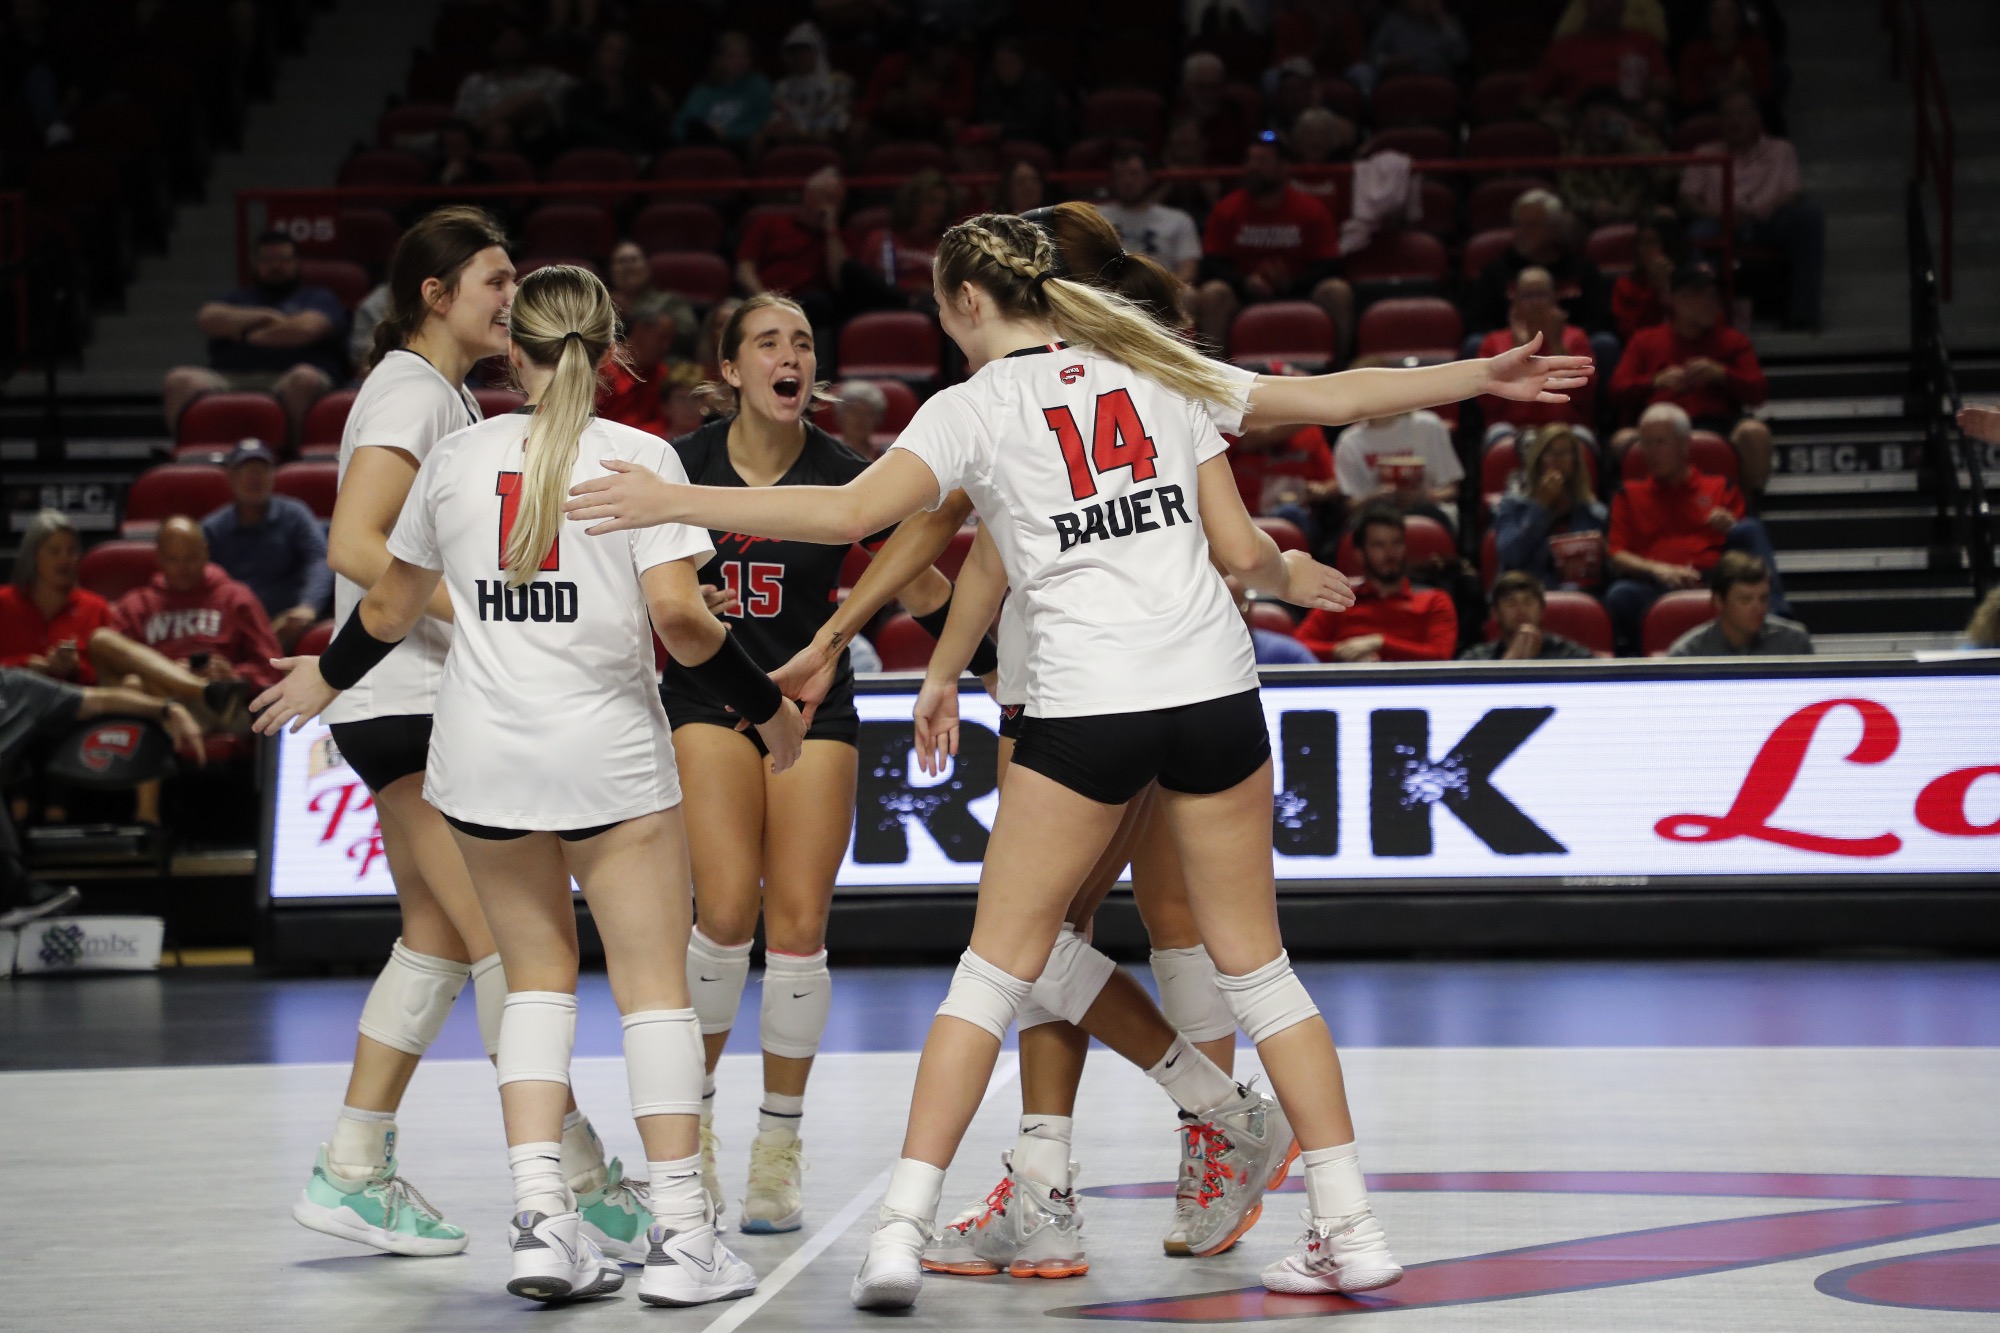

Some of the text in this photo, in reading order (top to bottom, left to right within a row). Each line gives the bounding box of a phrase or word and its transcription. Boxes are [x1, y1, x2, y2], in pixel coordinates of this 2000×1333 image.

[1042, 388, 1158, 501] 14
[1049, 484, 1193, 552] BAUER
[475, 579, 578, 623] HOOD
[720, 561, 785, 618] 15
[145, 609, 222, 644] WKU
